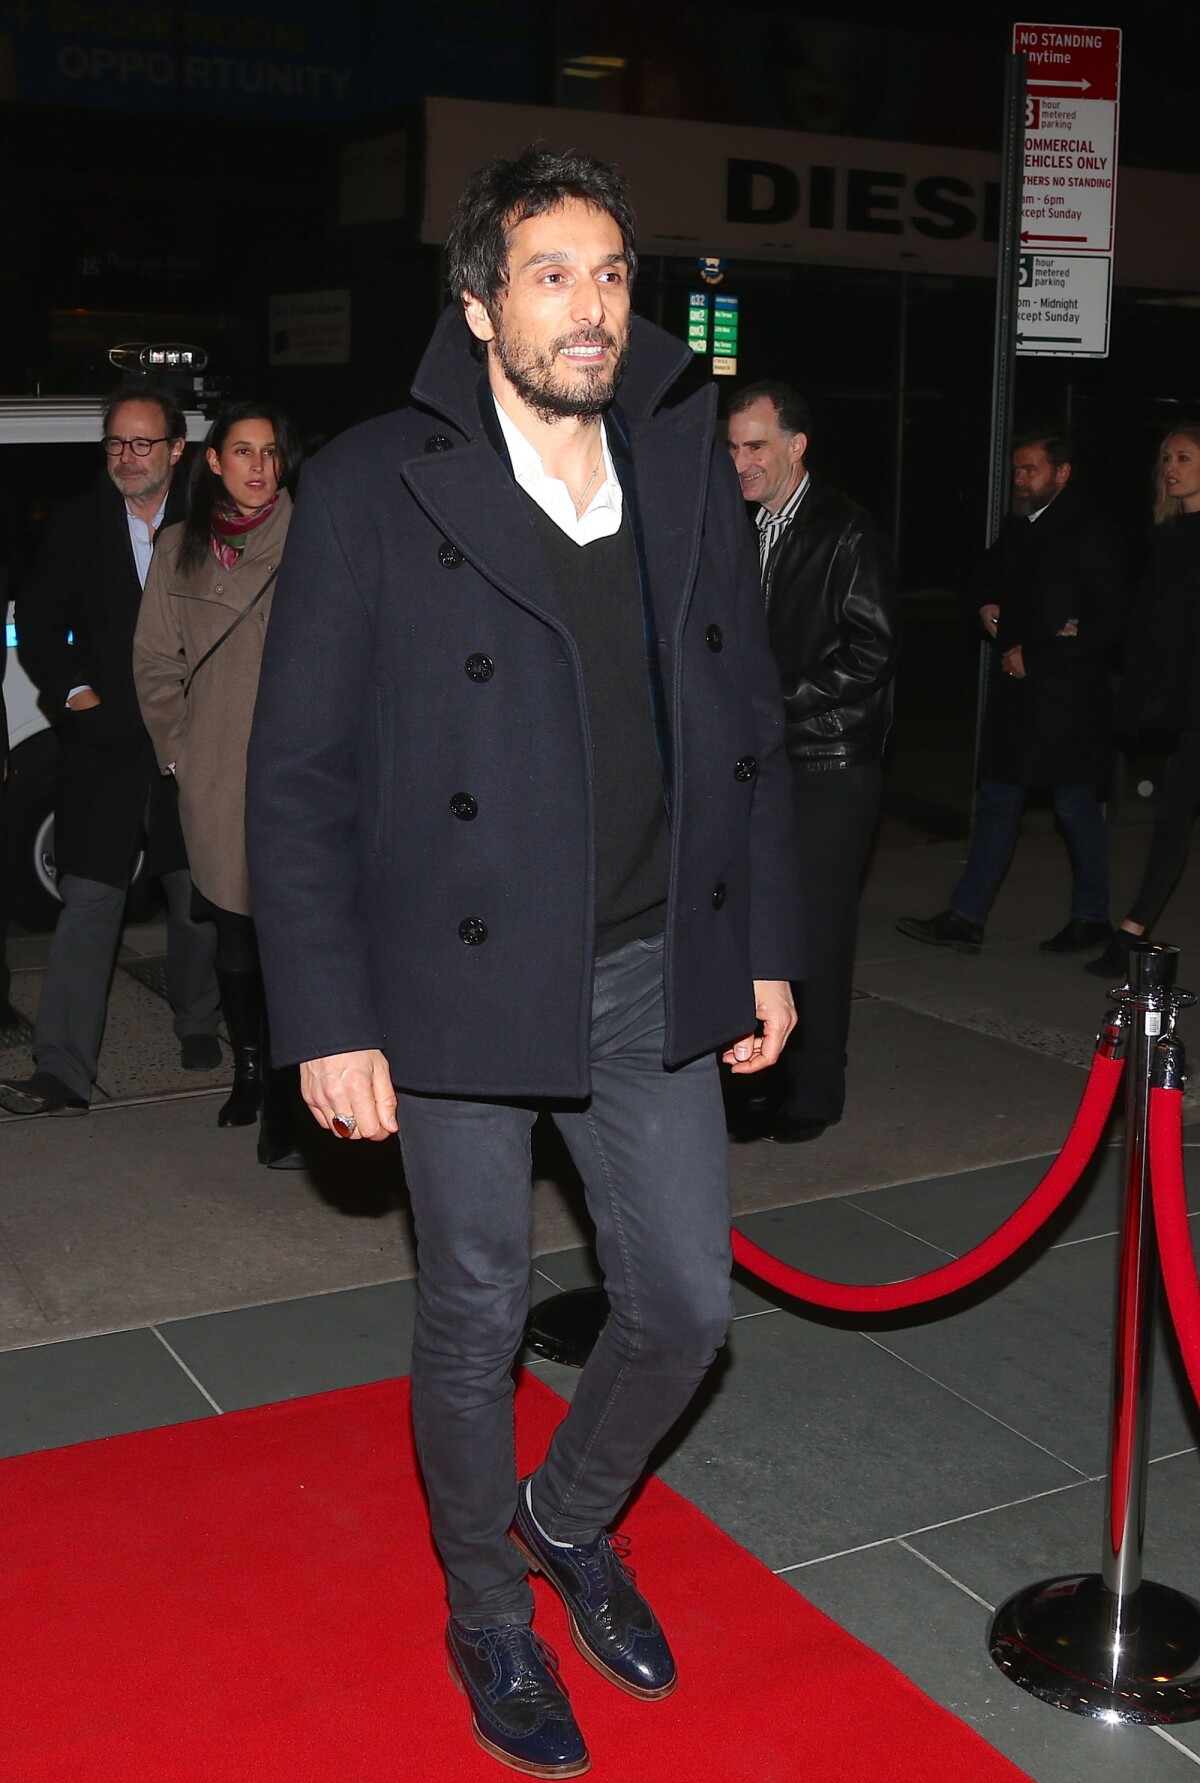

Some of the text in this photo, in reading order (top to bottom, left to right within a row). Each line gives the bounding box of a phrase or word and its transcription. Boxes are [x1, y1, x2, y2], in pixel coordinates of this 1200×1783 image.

[1020, 32, 1103, 48] NO STANDING
[1022, 48, 1072, 66] nytime
[58, 45, 352, 98] OPPORTUNITY
[1042, 101, 1061, 109] hour
[1042, 110, 1077, 120] metered
[1042, 120, 1072, 131] parking
[1025, 138, 1095, 153] OMMERCIAL
[1025, 154, 1107, 170] EHICLES ONLY
[1023, 175, 1111, 188] THERS NO STANDING
[726, 157, 1000, 243] DIES
[1044, 194, 1065, 206] 6pm
[1021, 207, 1082, 221] xcept Sunday
[1035, 258, 1054, 267] hour
[1035, 268, 1070, 278] metered
[1034, 278, 1065, 288] parking
[1040, 298, 1078, 312] Midnight
[1017, 311, 1080, 324] xcept Sunday
